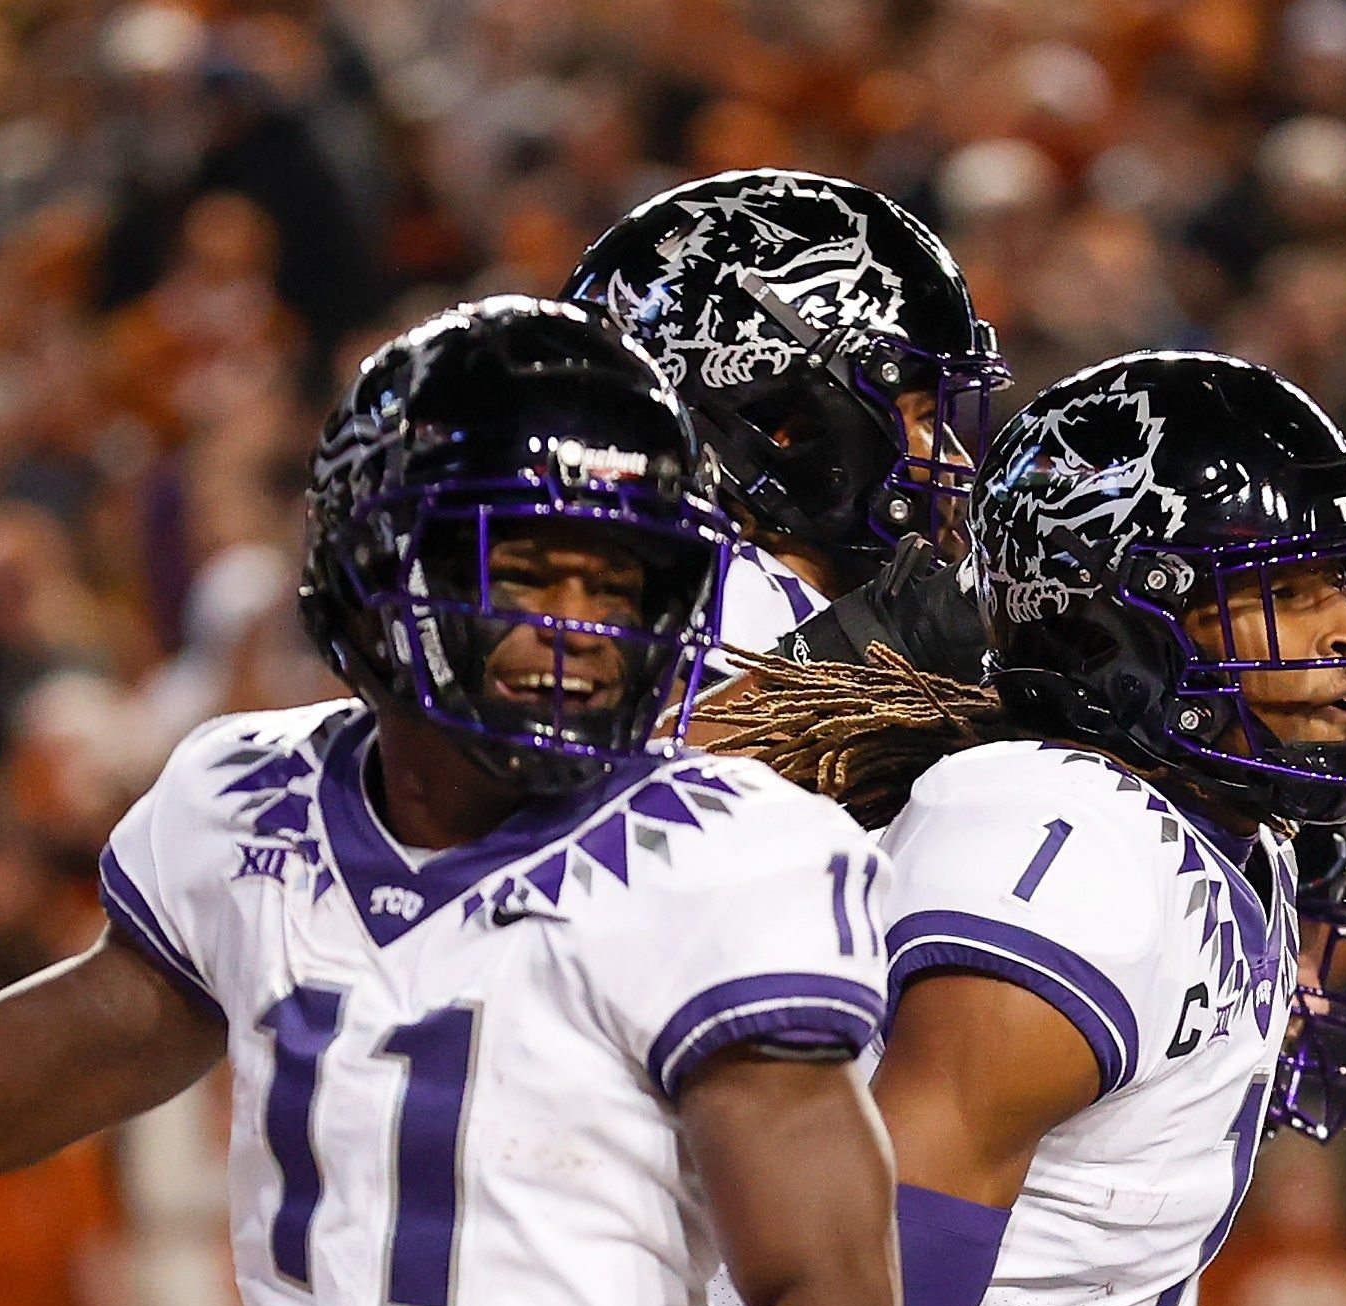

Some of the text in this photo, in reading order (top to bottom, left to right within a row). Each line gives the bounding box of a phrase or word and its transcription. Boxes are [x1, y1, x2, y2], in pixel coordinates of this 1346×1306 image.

[1011, 817, 1074, 903] 1
[370, 885, 425, 922] TCU
[824, 851, 879, 957] 11
[1165, 980, 1209, 1059] C
